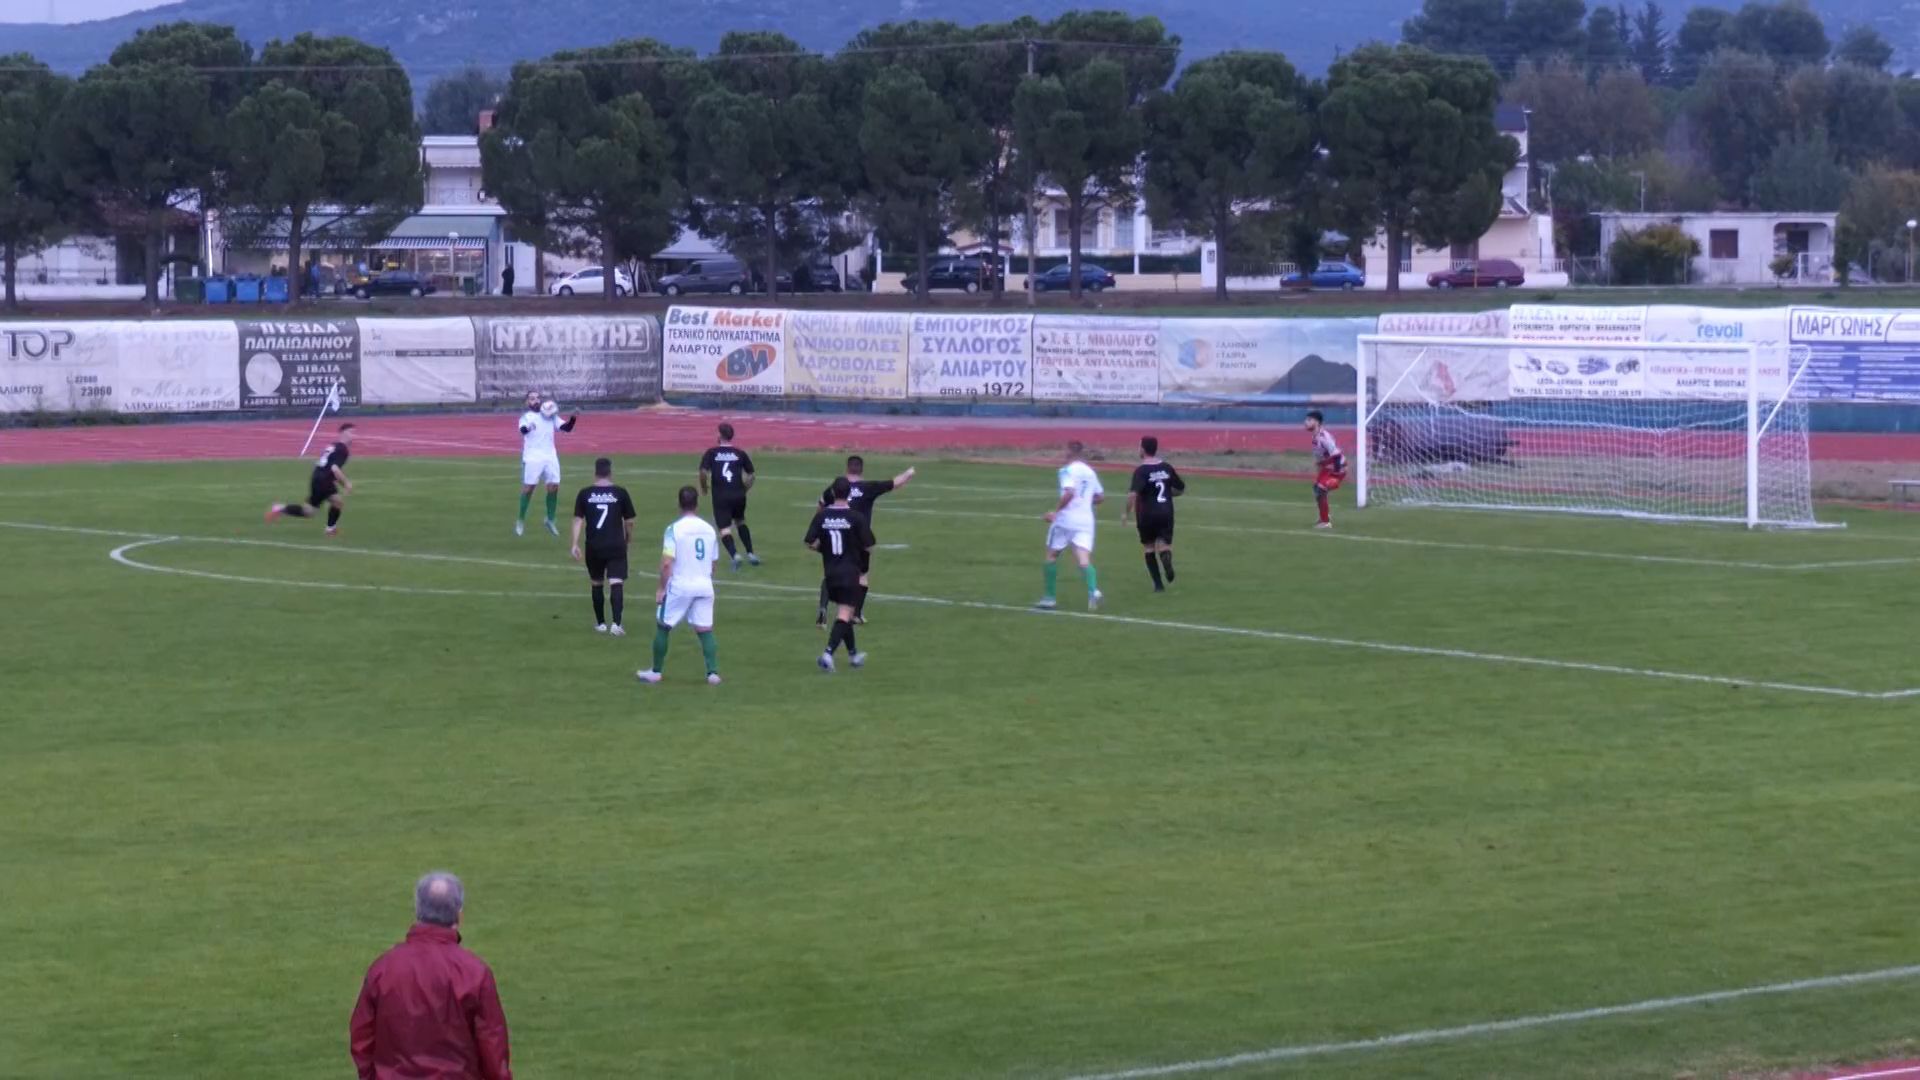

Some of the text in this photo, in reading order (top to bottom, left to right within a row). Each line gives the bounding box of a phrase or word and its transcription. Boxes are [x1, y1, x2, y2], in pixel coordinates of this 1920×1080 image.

[669, 308, 783, 328] Best Market
[914, 316, 1027, 333] ΕΜΠΟΡΙΚΟΣ
[1796, 314, 1883, 337] ΜΑΡΓΩΝΗΣ
[668, 328, 781, 343] ΤΕΧΝΙΚΟ ΠΟΛΥΚΑΤΑΣΤΗΜΑ
[1697, 321, 1743, 338] revoil
[245, 337, 353, 350] ΠΑΠΑΙΩΑΝΝΟΥ
[669, 344, 722, 355] ΑΛΙΑΡΤΟΣ
[922, 336, 1022, 354] ΣΥΛΛΟΓΟΣ
[727, 347, 770, 377] BM
[940, 359, 1027, 377] ΑΛΙΑΡΤΟΥ
[291, 387, 348, 395] ΣΧΟΛΙΑ
[983, 382, 1025, 396] 1972
[721, 462, 733, 483] 4
[1155, 481, 1167, 502] 2
[596, 504, 609, 529] 7
[694, 538, 706, 561] 9
[829, 530, 843, 555] 11
